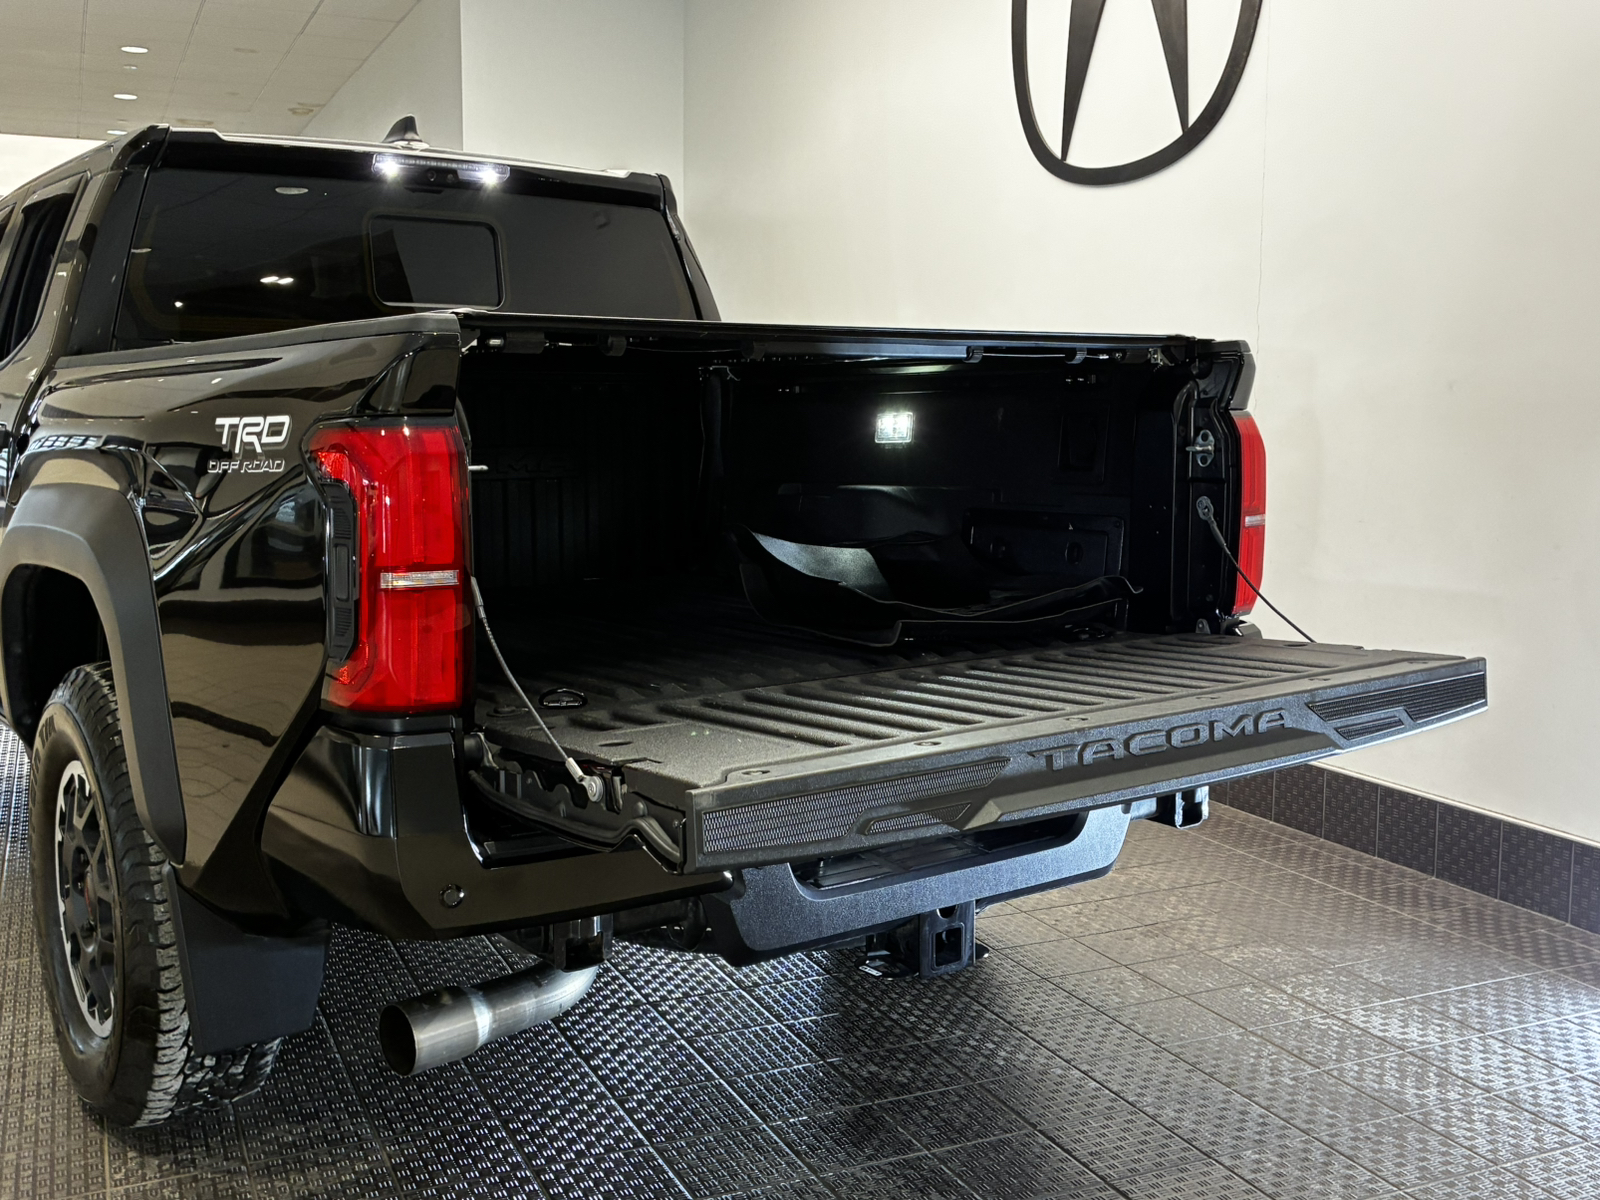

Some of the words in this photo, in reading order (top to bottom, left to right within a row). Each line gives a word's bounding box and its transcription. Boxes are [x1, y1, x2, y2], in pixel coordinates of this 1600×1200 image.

[214, 414, 291, 455] TRD
[207, 459, 240, 473] OFF
[240, 459, 285, 473] ROAD
[1027, 707, 1289, 771] TACOMA
